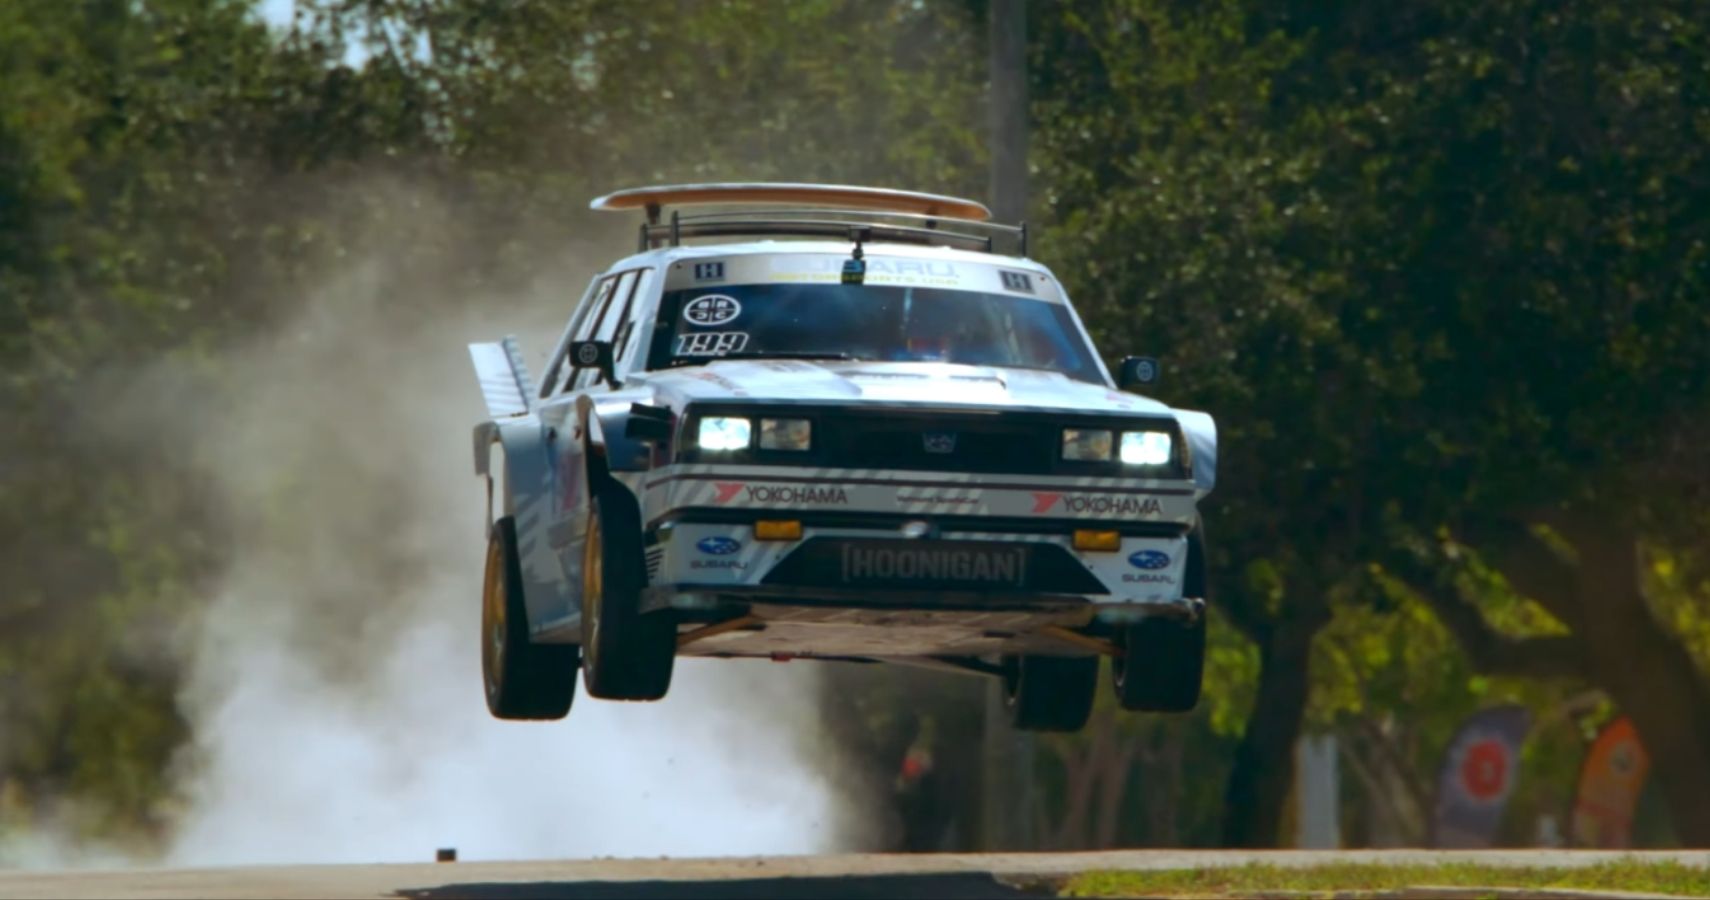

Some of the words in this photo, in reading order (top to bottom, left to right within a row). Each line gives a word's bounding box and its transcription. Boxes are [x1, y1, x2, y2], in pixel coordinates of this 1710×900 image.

[676, 331, 750, 356] 199
[746, 486, 848, 504] YOKOHAMA
[1063, 496, 1163, 514] YOKOHAMA
